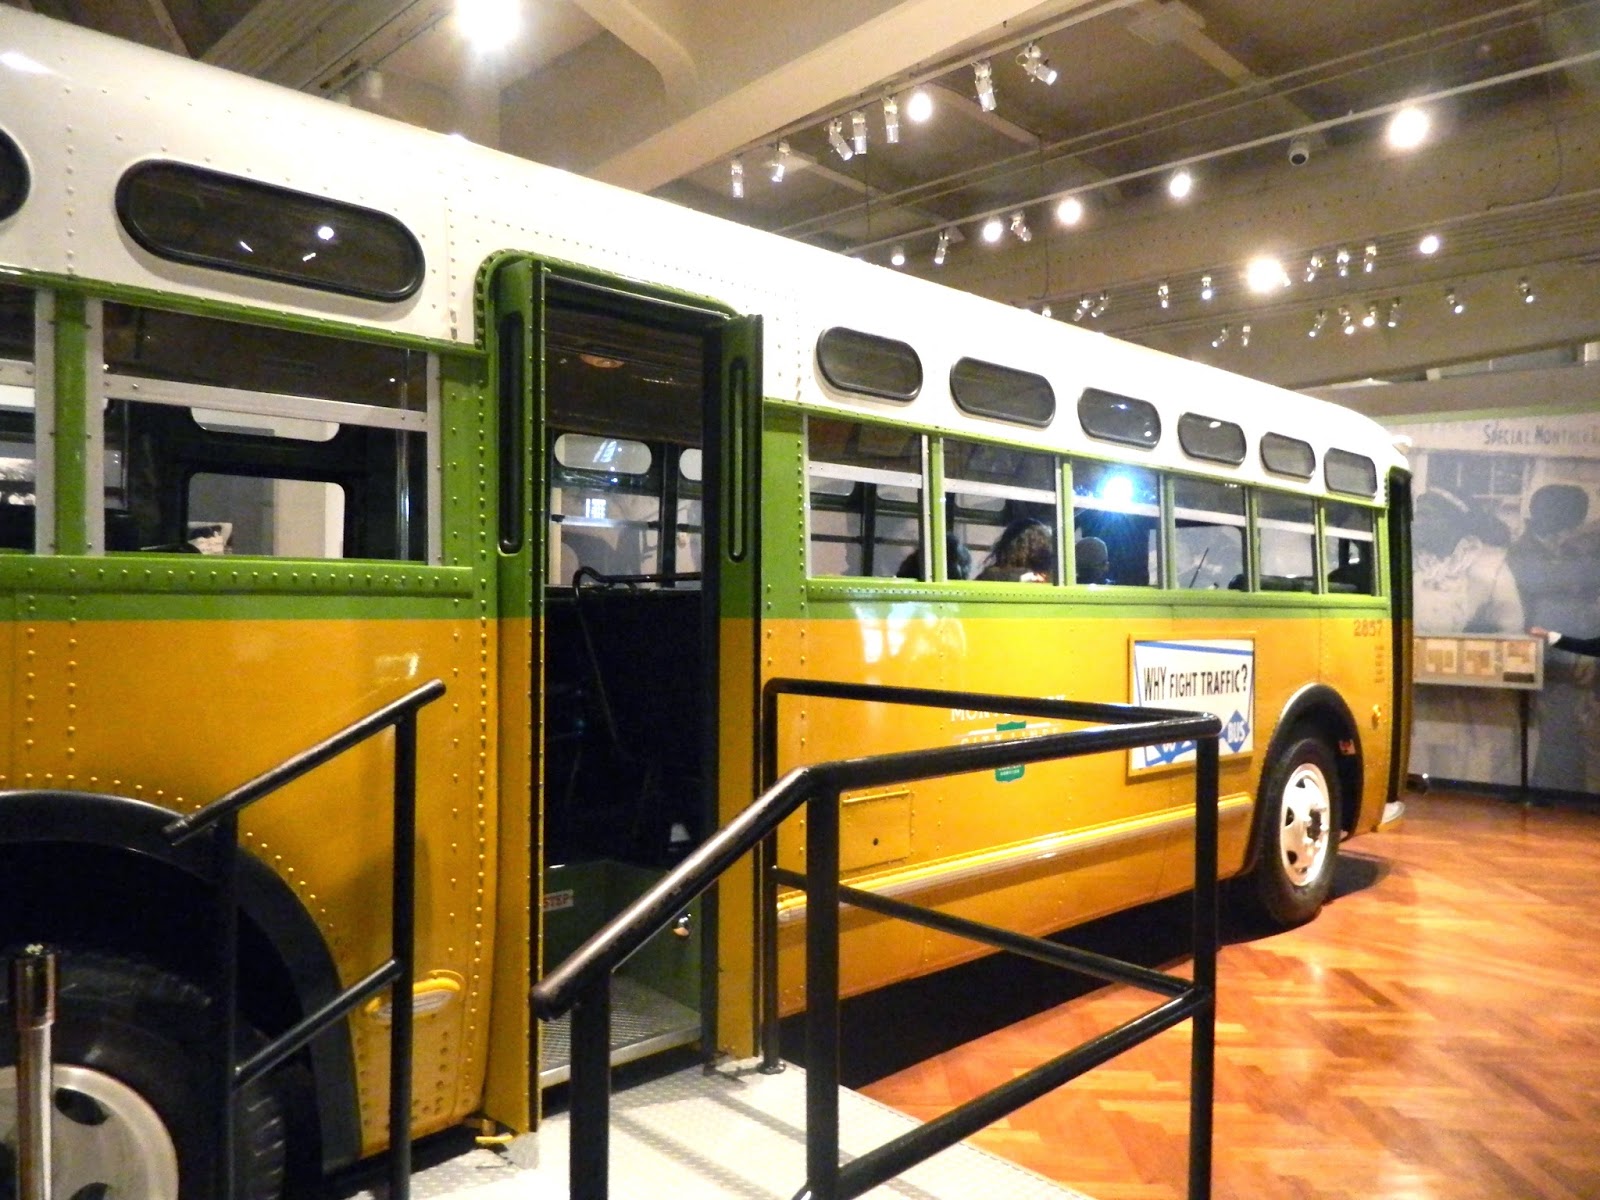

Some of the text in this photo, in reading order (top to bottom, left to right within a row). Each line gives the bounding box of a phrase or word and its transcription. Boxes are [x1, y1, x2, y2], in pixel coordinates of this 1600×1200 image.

[1353, 619, 1382, 637] 2857
[1143, 664, 1248, 701] WHY FIGHT TRAFFIC?
[1227, 721, 1246, 743] BUS
